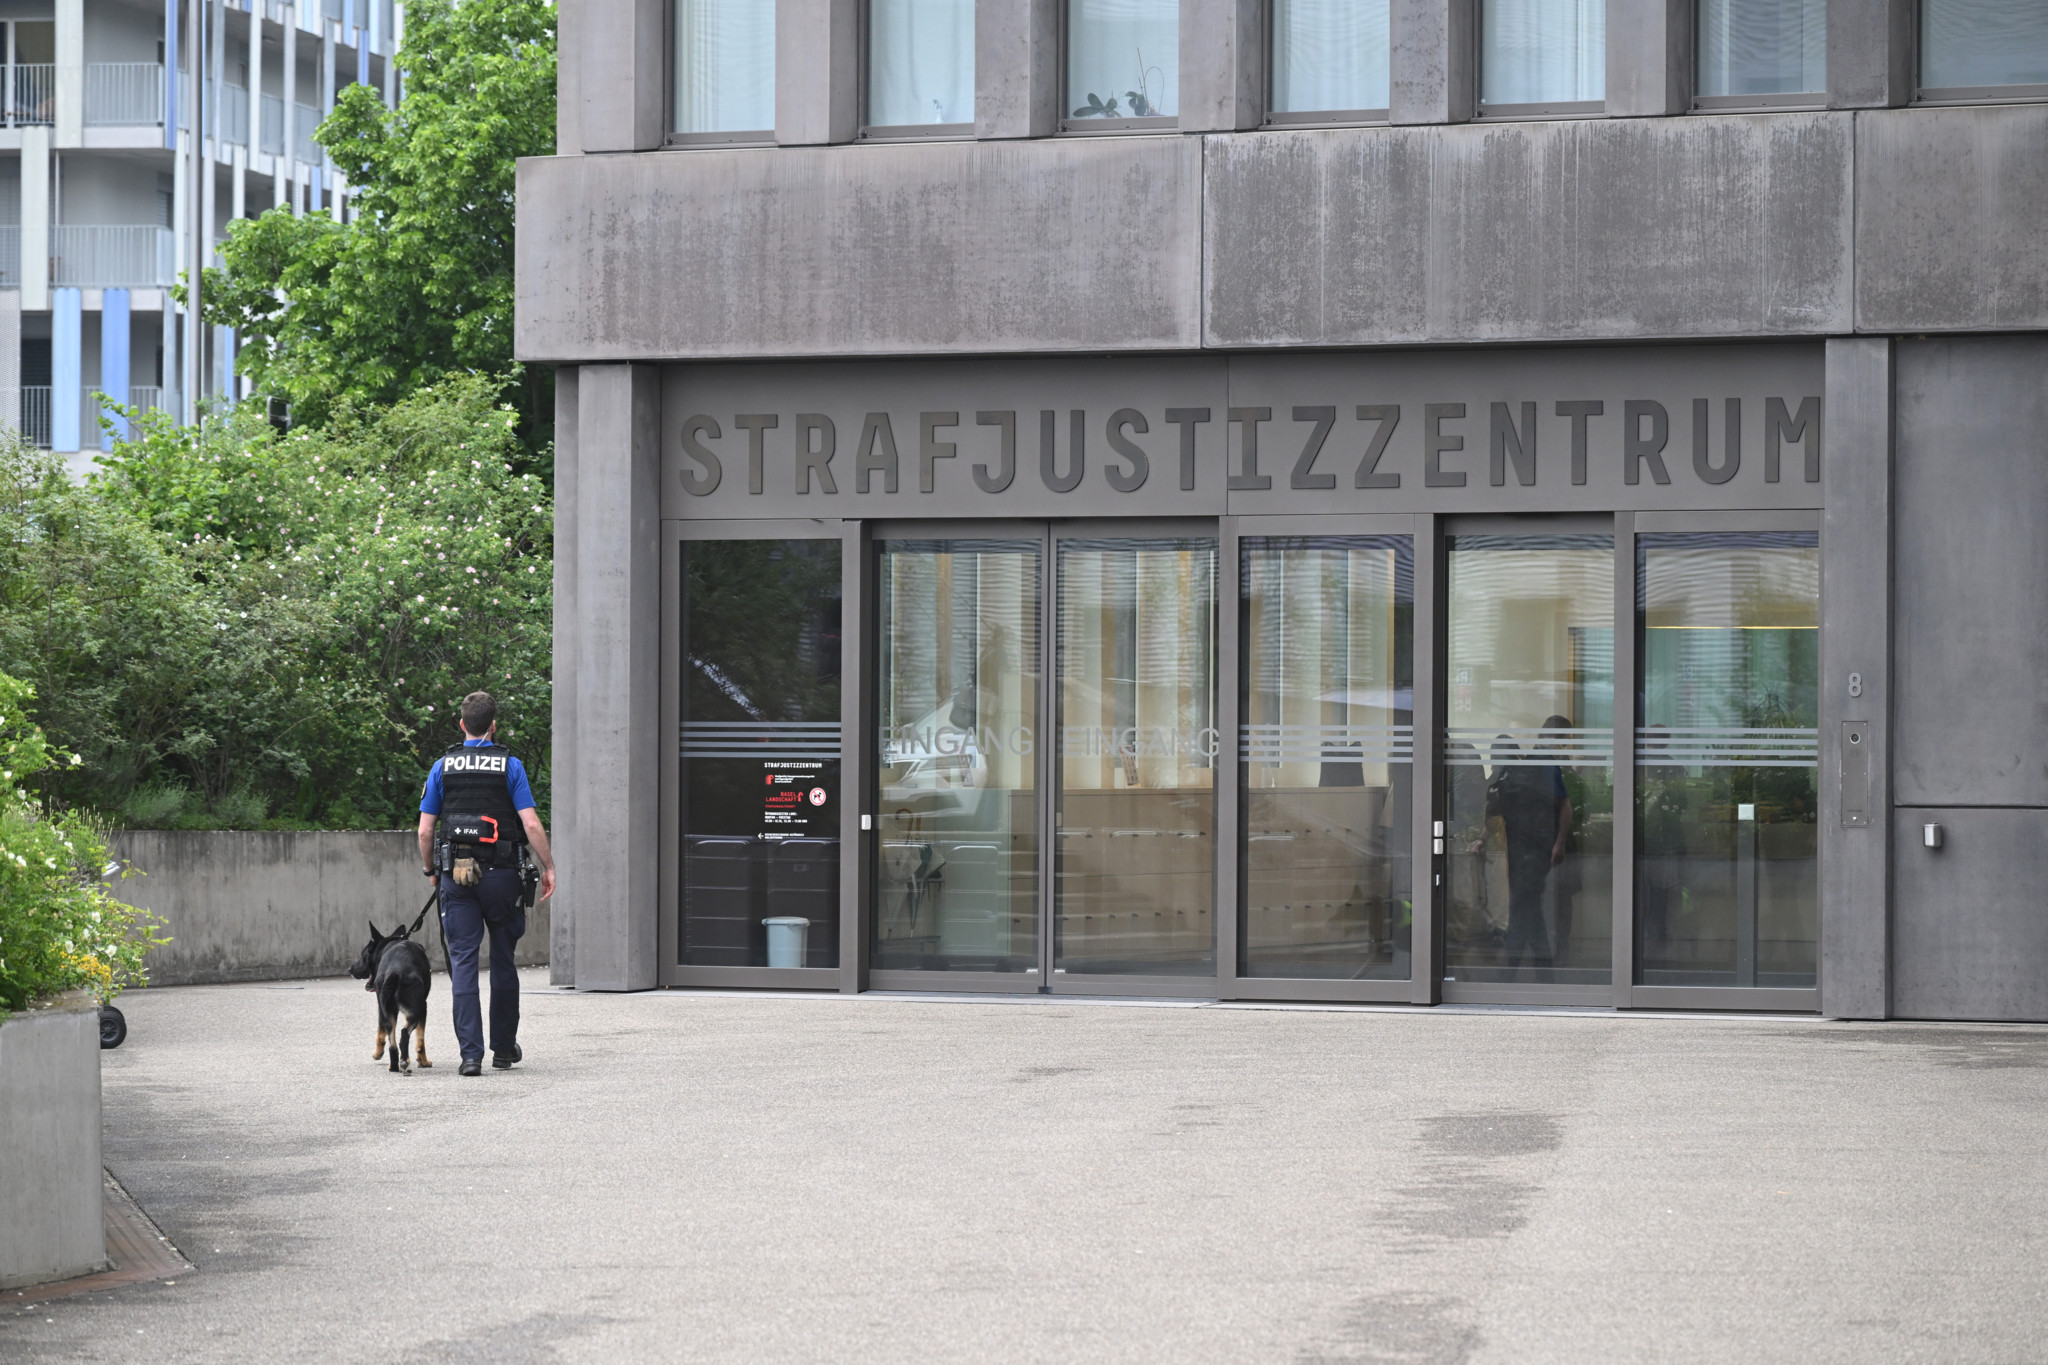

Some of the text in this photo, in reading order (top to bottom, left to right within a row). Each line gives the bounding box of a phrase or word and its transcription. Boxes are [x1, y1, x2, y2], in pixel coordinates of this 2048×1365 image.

[679, 396, 1820, 496] STRAFJUSTIZZENTRUM
[1848, 672, 1862, 697] 8
[878, 726, 1034, 756] EINGANG
[1062, 726, 1220, 757] EINGANG
[444, 755, 506, 772] POLIZEI
